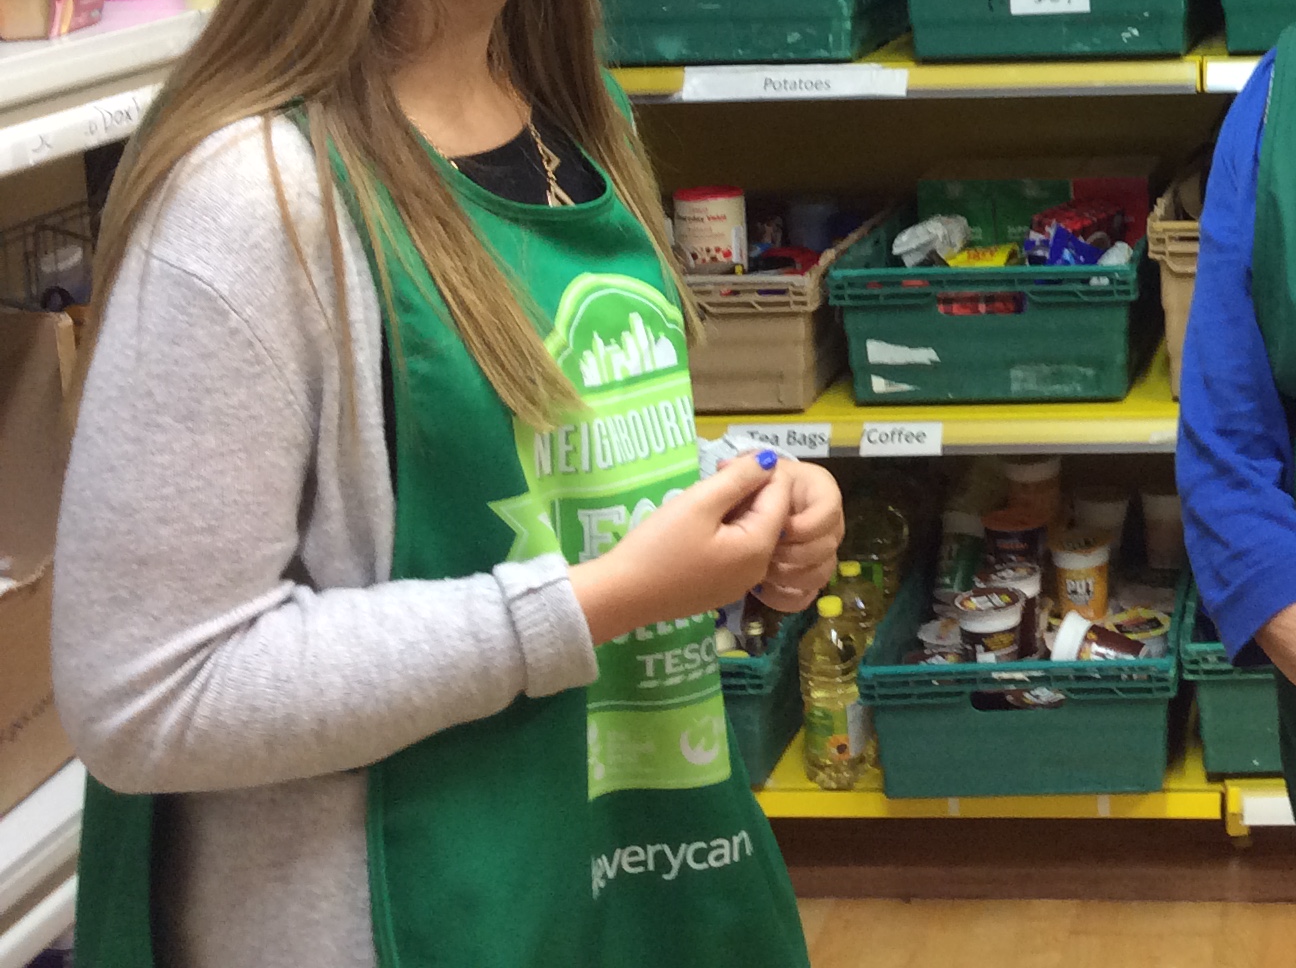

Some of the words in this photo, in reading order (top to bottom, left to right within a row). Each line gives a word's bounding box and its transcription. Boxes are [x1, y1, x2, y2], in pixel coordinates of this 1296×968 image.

[763, 76, 832, 92] Potatoes
[786, 429, 828, 450] Bags
[866, 427, 927, 445] Coffee
[636, 636, 718, 678] TESC
